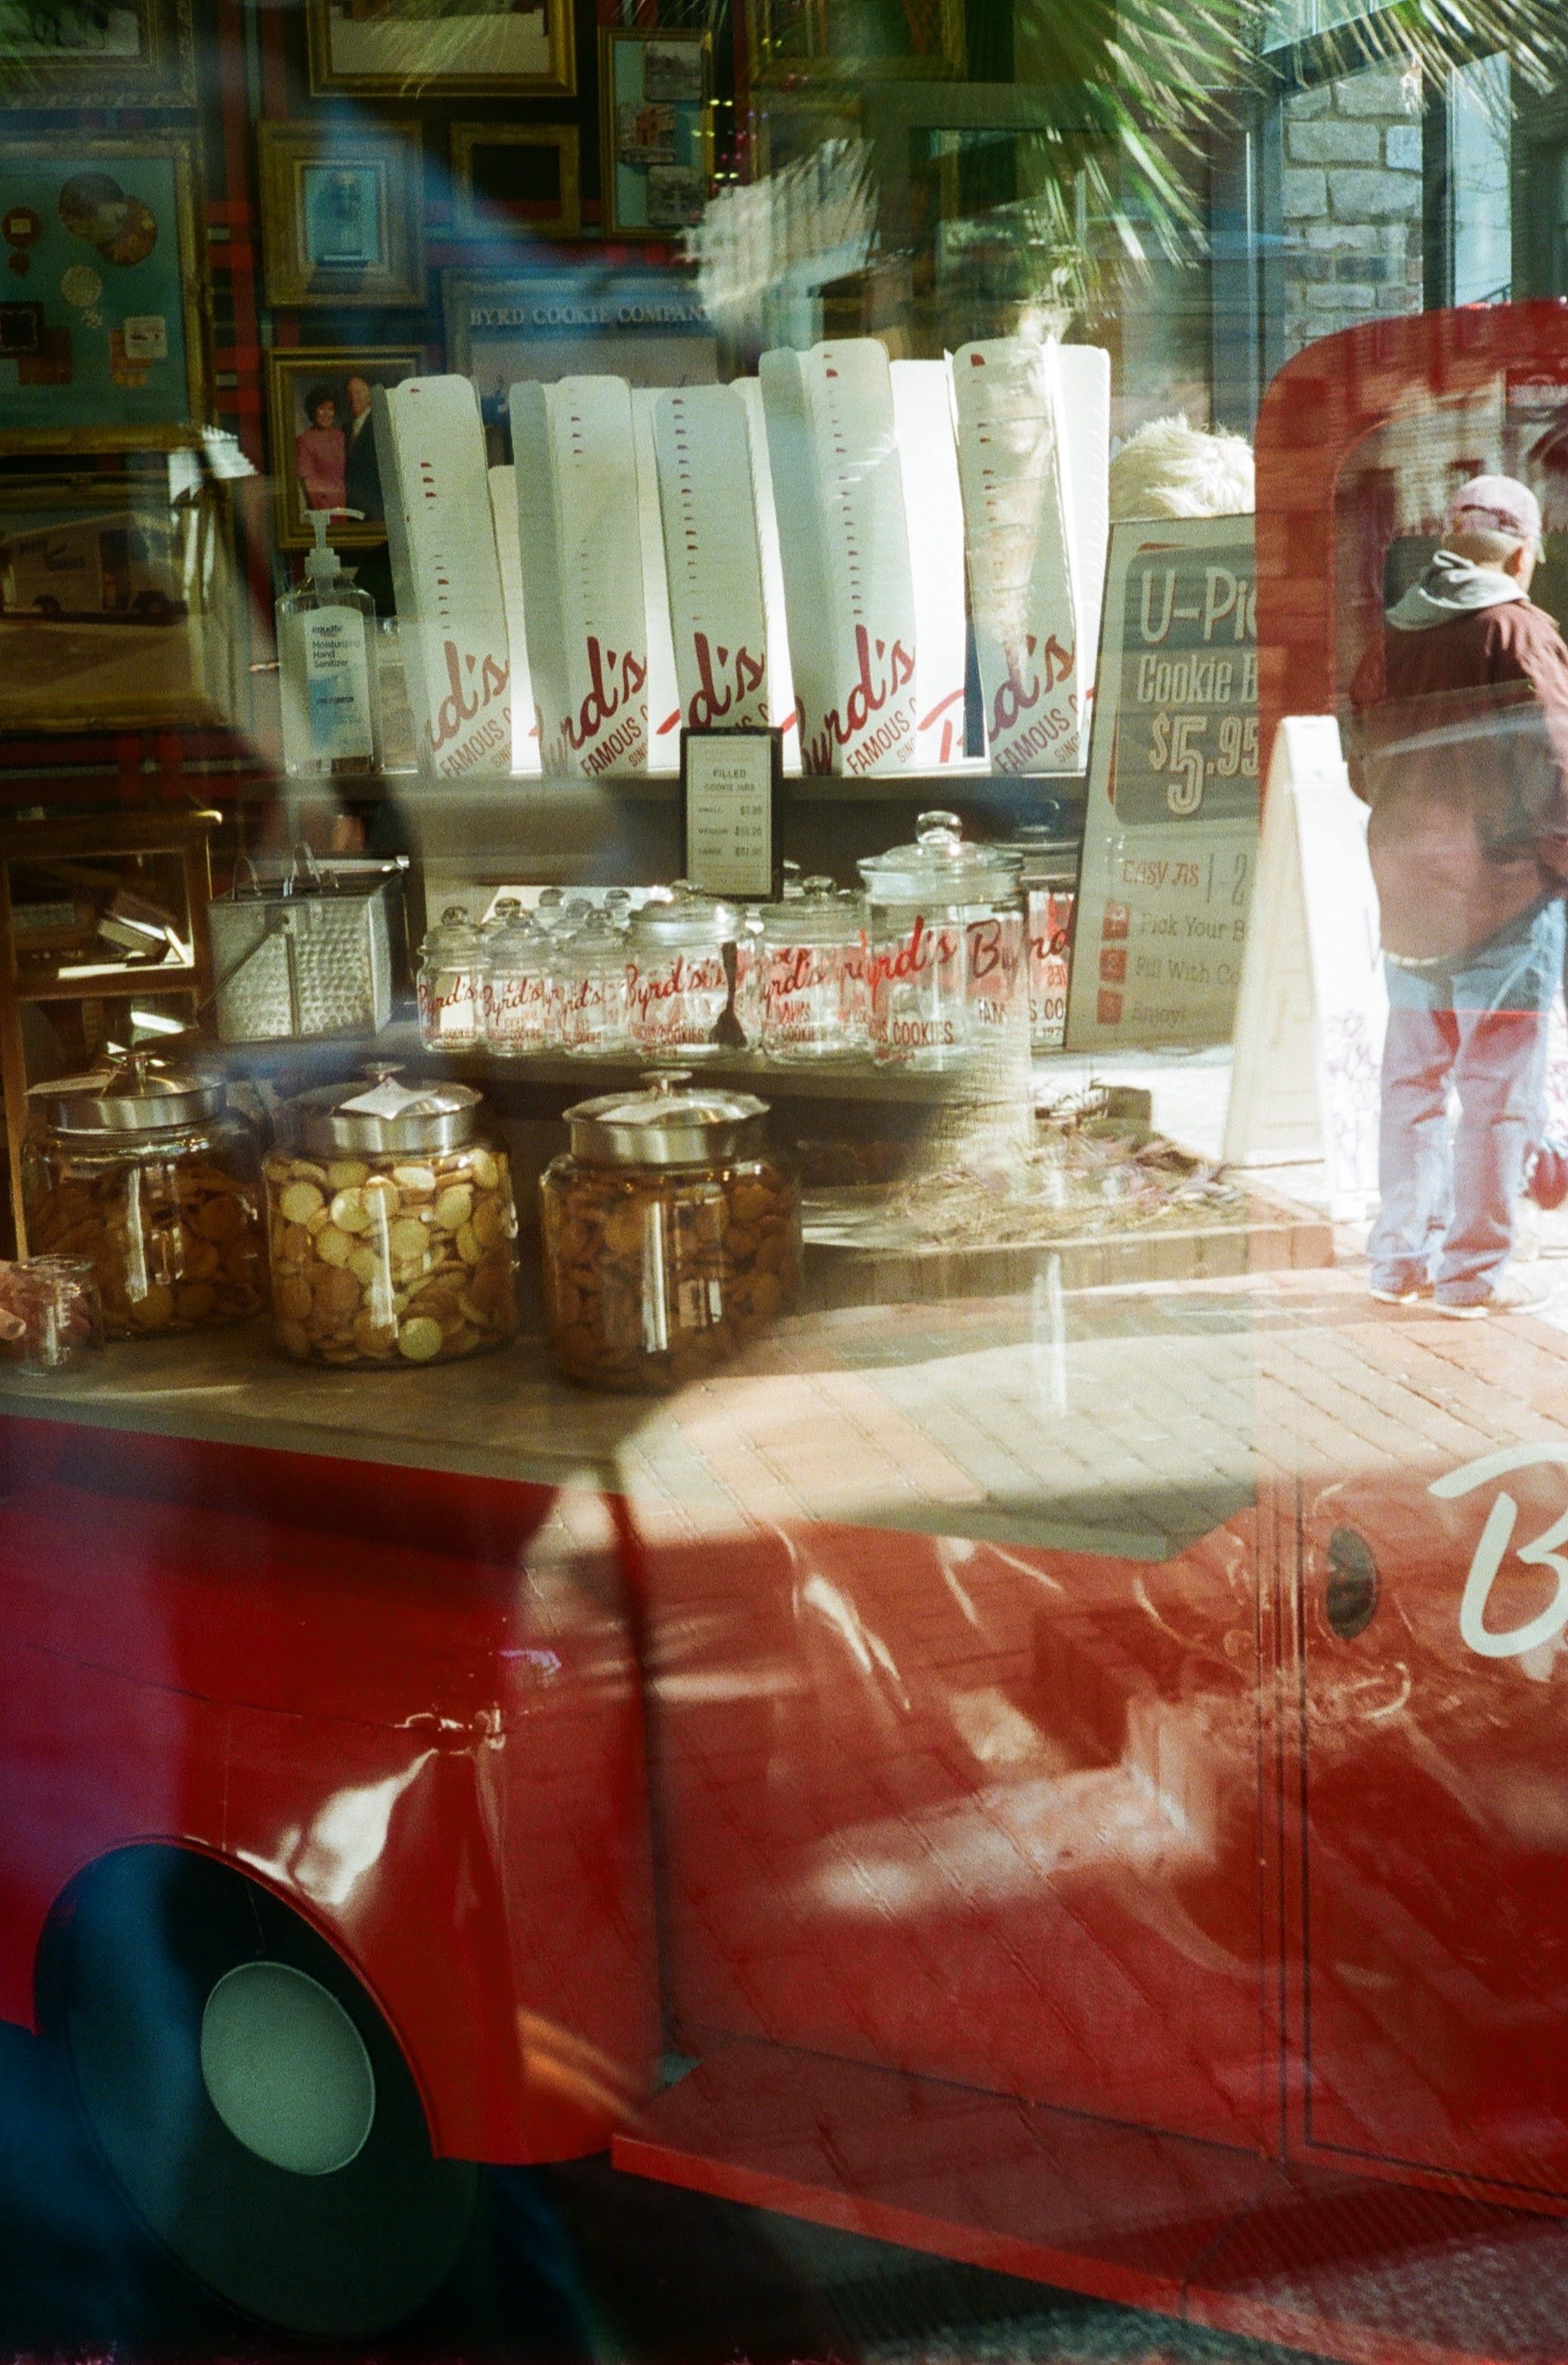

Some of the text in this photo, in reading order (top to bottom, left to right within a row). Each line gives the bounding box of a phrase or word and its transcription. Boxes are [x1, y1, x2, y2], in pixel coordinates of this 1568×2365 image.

[469, 308, 525, 325] BYRD
[532, 306, 606, 325] COOKIE
[313, 650, 336, 660] Hand
[314, 659, 348, 669] Sanitizer
[1137, 653, 1233, 704] Cookie
[439, 718, 506, 778] FAMOUS
[580, 716, 642, 777] FAMOUS
[846, 710, 911, 775] FAMOUS
[993, 707, 1071, 774] FAMOUS
[1147, 712, 1260, 816] $5.95
[712, 768, 747, 778] FILLED
[1140, 911, 1178, 938] Pick
[1186, 915, 1229, 939] Your
